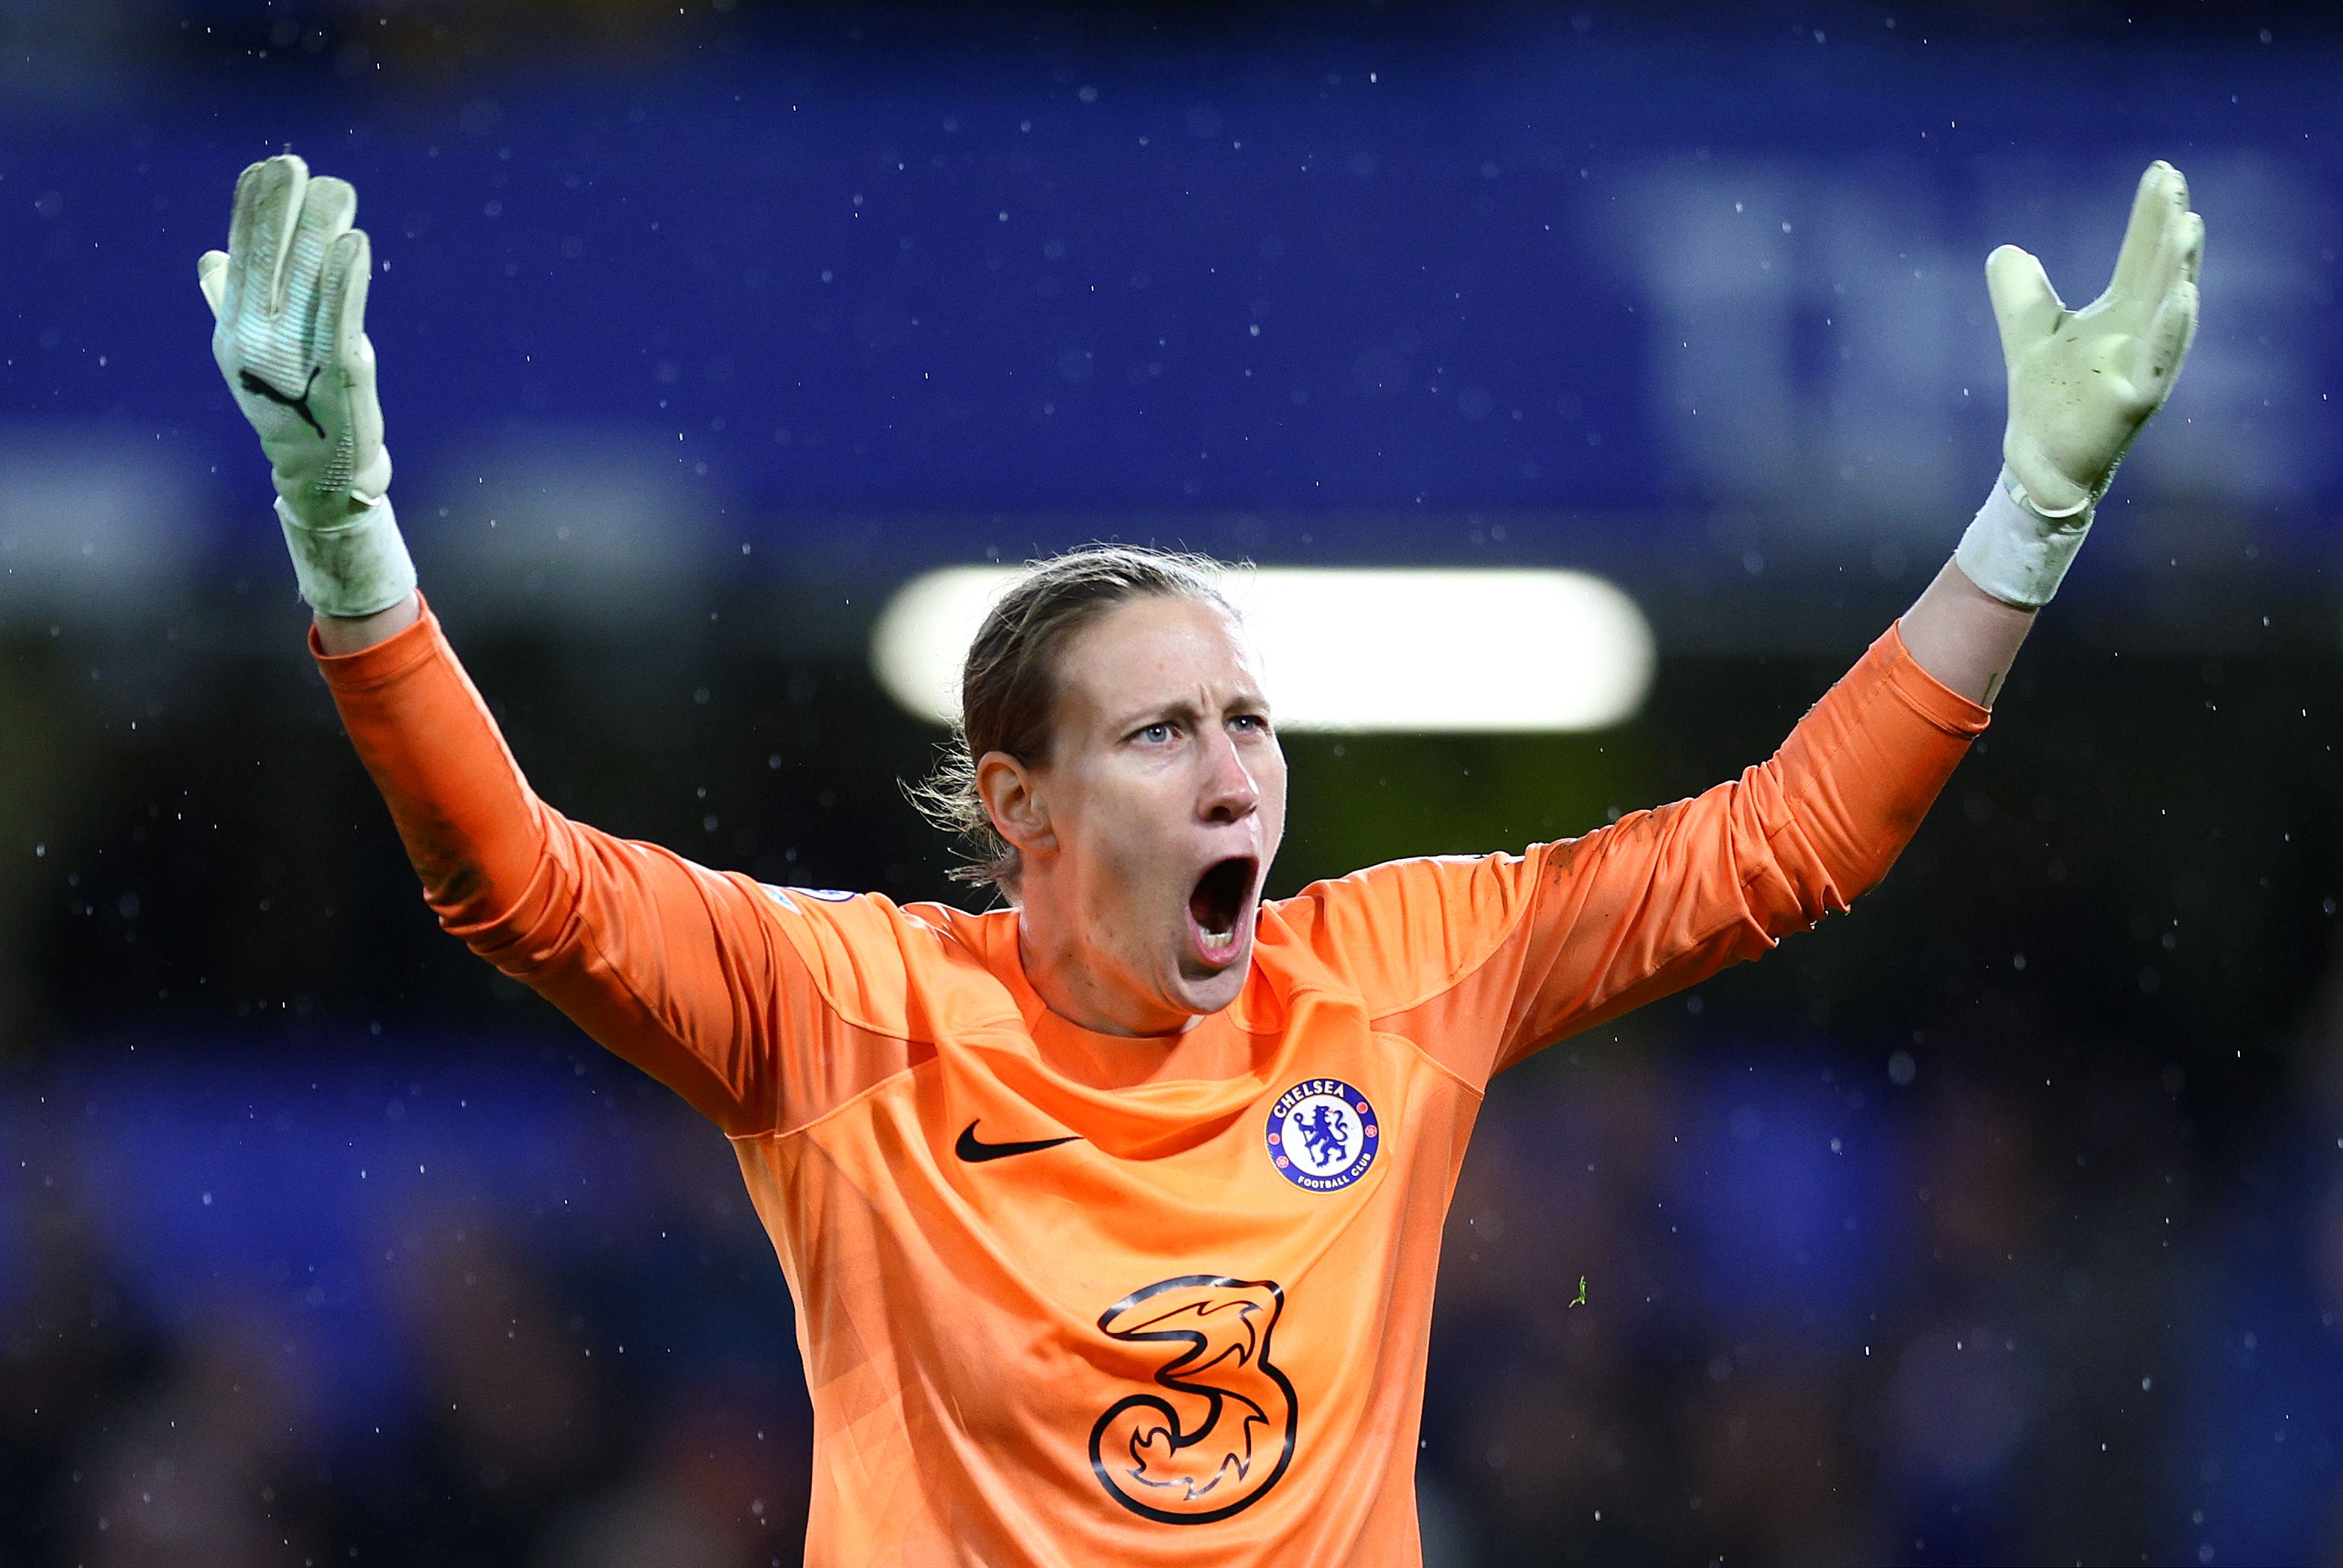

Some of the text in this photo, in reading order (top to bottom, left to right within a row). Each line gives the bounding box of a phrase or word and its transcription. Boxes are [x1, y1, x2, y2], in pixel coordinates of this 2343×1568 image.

[1273, 1081, 1344, 1118] CHELSEA
[1297, 1152, 1371, 1189] FOOTBALL CLUB
